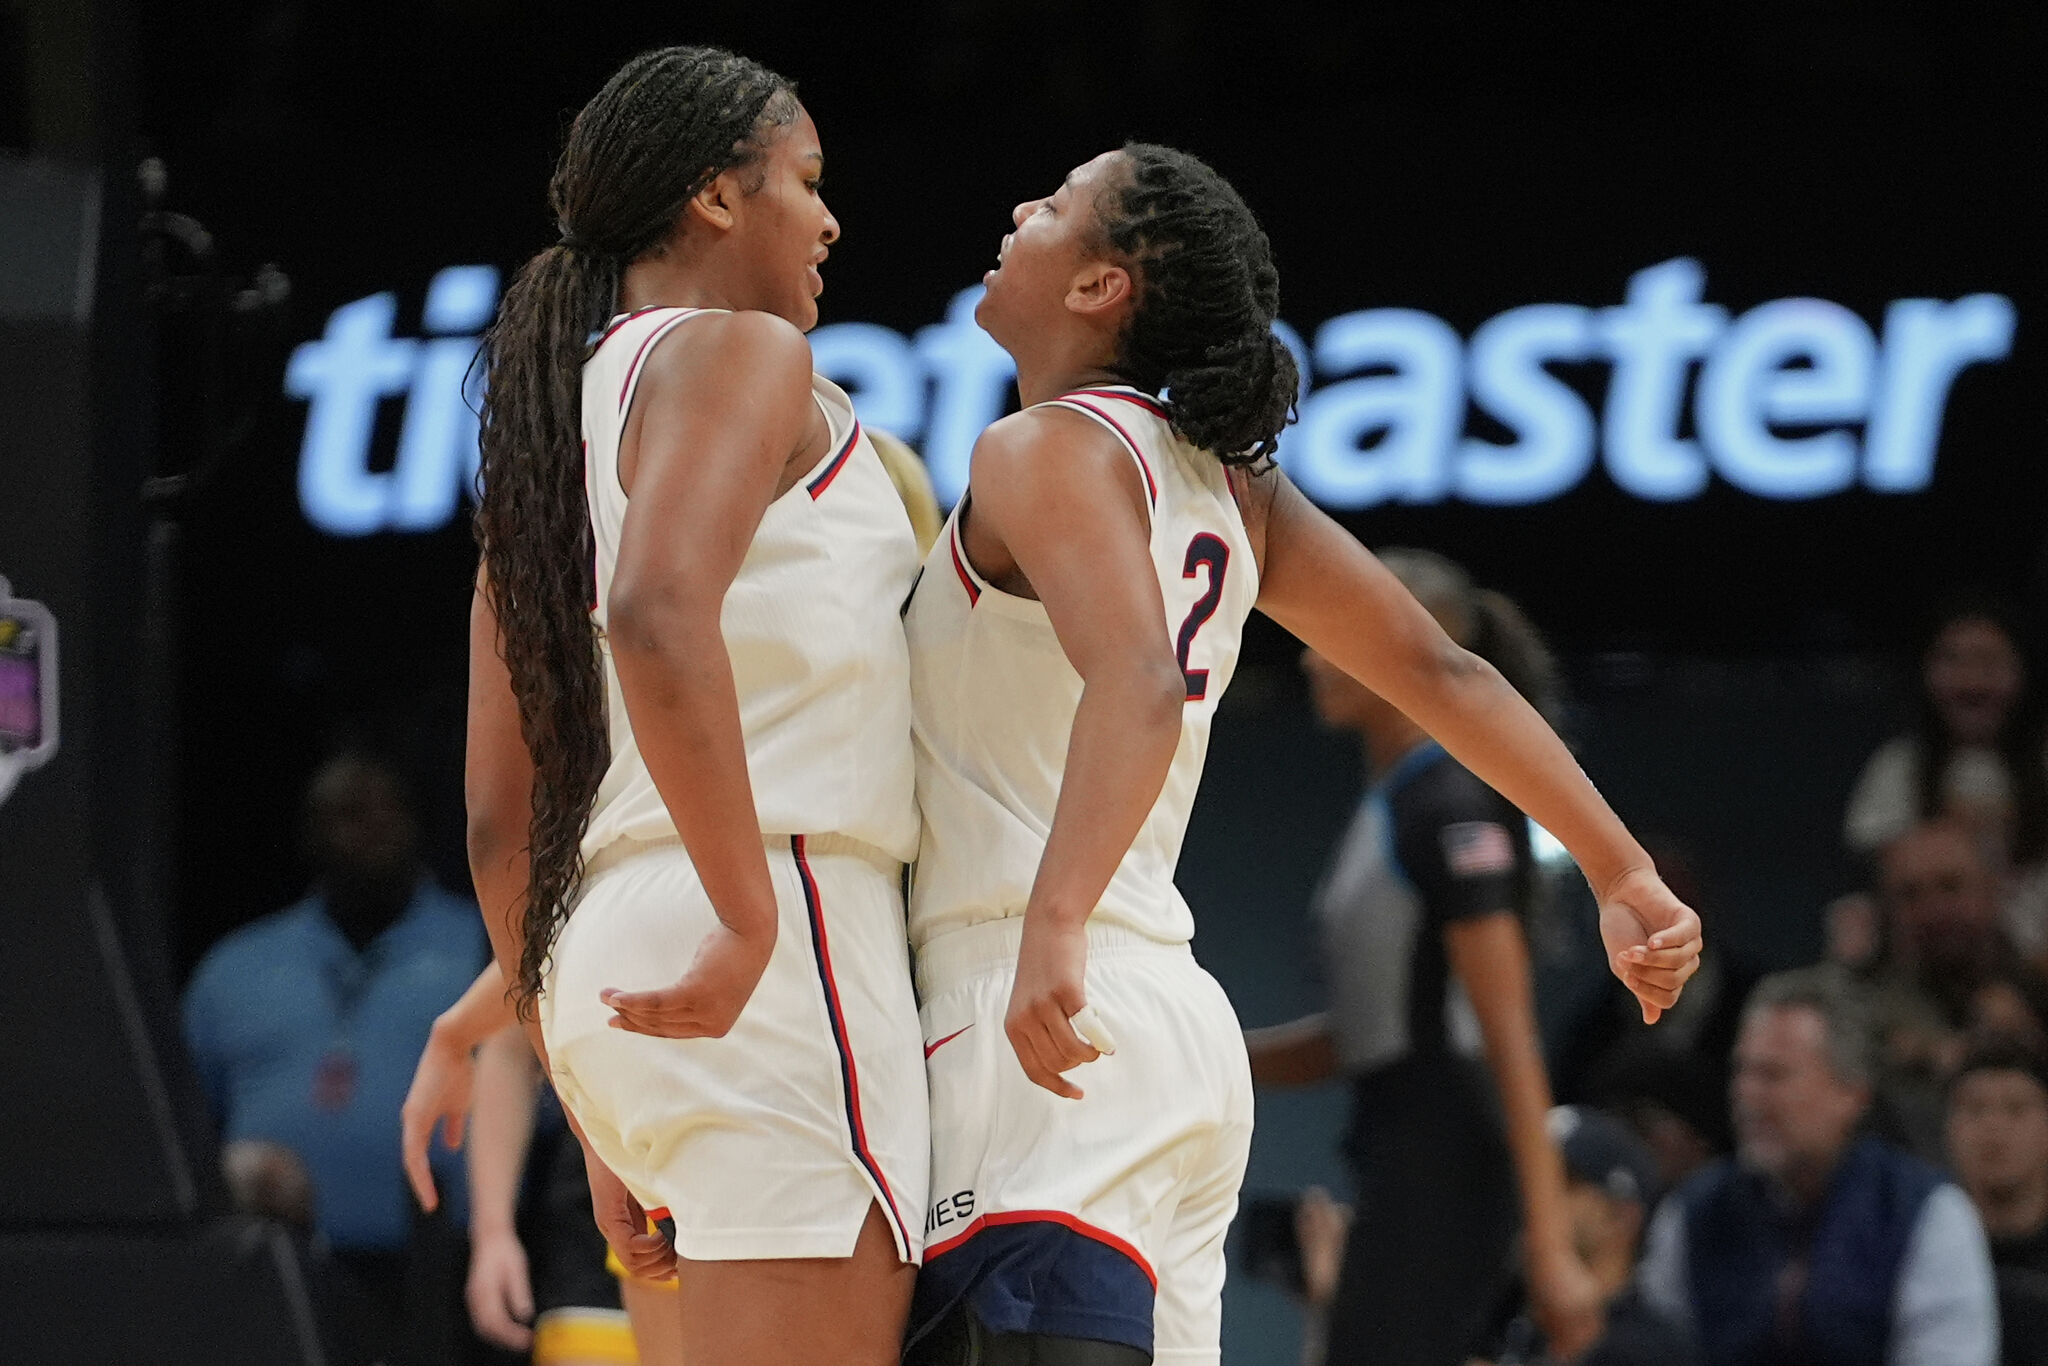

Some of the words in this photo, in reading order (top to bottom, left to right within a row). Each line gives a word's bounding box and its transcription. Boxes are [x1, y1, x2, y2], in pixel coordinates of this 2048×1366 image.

[284, 258, 2016, 536] tietaster
[1177, 532, 1230, 701] 2
[925, 1190, 975, 1233] IES
